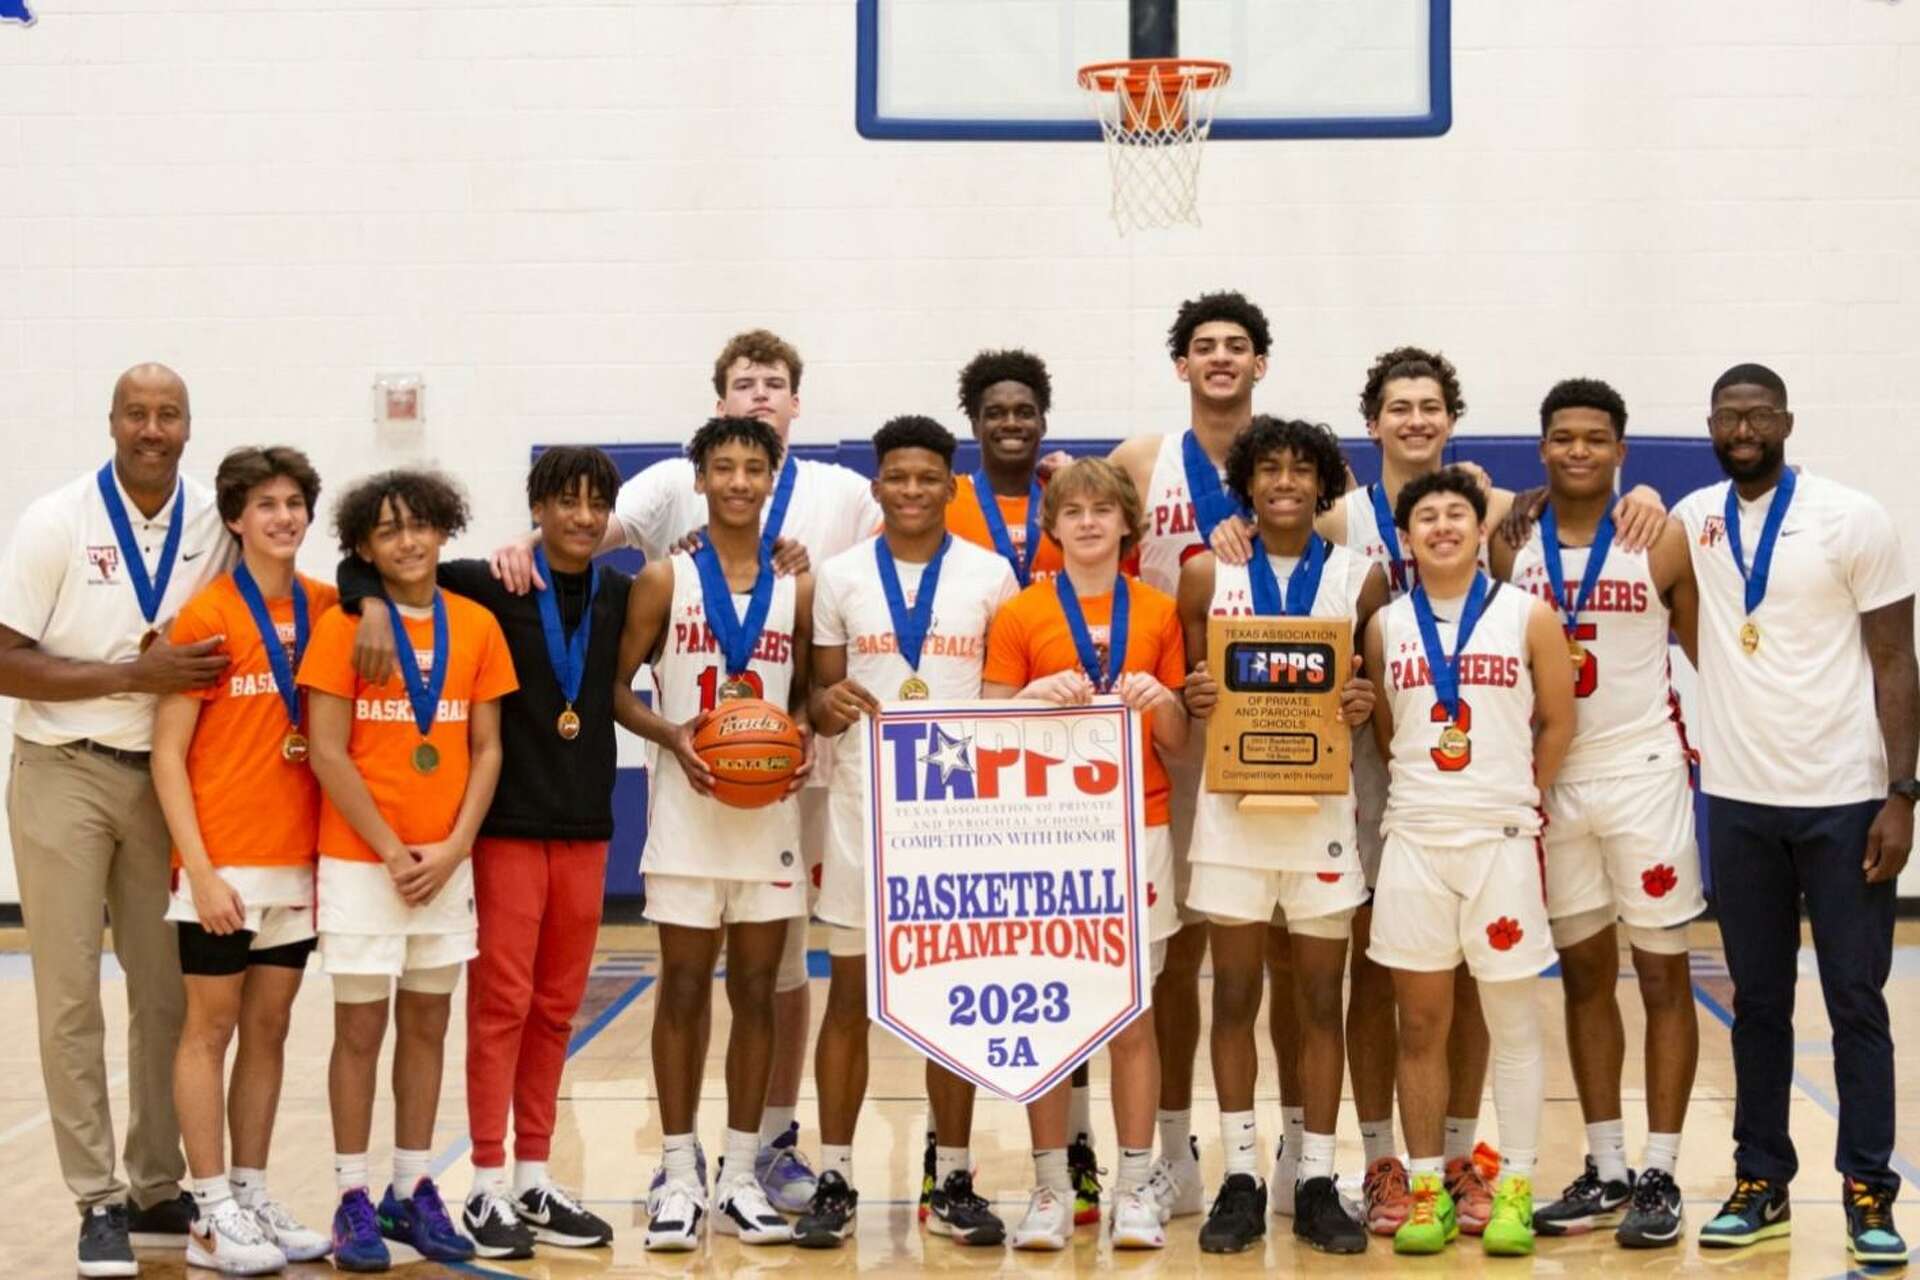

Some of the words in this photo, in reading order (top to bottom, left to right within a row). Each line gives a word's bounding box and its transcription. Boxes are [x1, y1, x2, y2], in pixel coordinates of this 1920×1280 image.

[1225, 629, 1260, 640] TEXAS
[1262, 629, 1337, 641] ASSOCIATION
[1235, 651, 1326, 684] TAPPS
[1248, 696, 1263, 706] OF
[1265, 696, 1311, 706] PRIVATE
[1235, 707, 1260, 717] AND
[1261, 708, 1323, 718] PAROCHIAL
[1252, 719, 1307, 730] SCHOOLS
[1430, 697, 1472, 772] 3
[883, 717, 1120, 802] TAPPS
[1222, 769, 1281, 781] Competition
[1283, 770, 1303, 780] with
[1305, 770, 1334, 780] Honor
[895, 806, 939, 817] TEXAS
[942, 804, 1032, 816] ASSOCIATION
[1036, 803, 1052, 812] OF
[1059, 801, 1114, 811] PRIVATE
[911, 820, 942, 830] AND
[948, 817, 1028, 829] PAROCHIAL
[1035, 815, 1101, 827] SCHOOLS
[891, 834, 1003, 849] COMPETITION
[1007, 831, 1052, 846] WITH
[1056, 829, 1116, 845] HONOR
[887, 869, 1124, 921] BASKETBALL
[889, 917, 1126, 975] CHAMPIONS
[948, 981, 1070, 1026] 2023
[987, 1036, 1039, 1067] 5A
